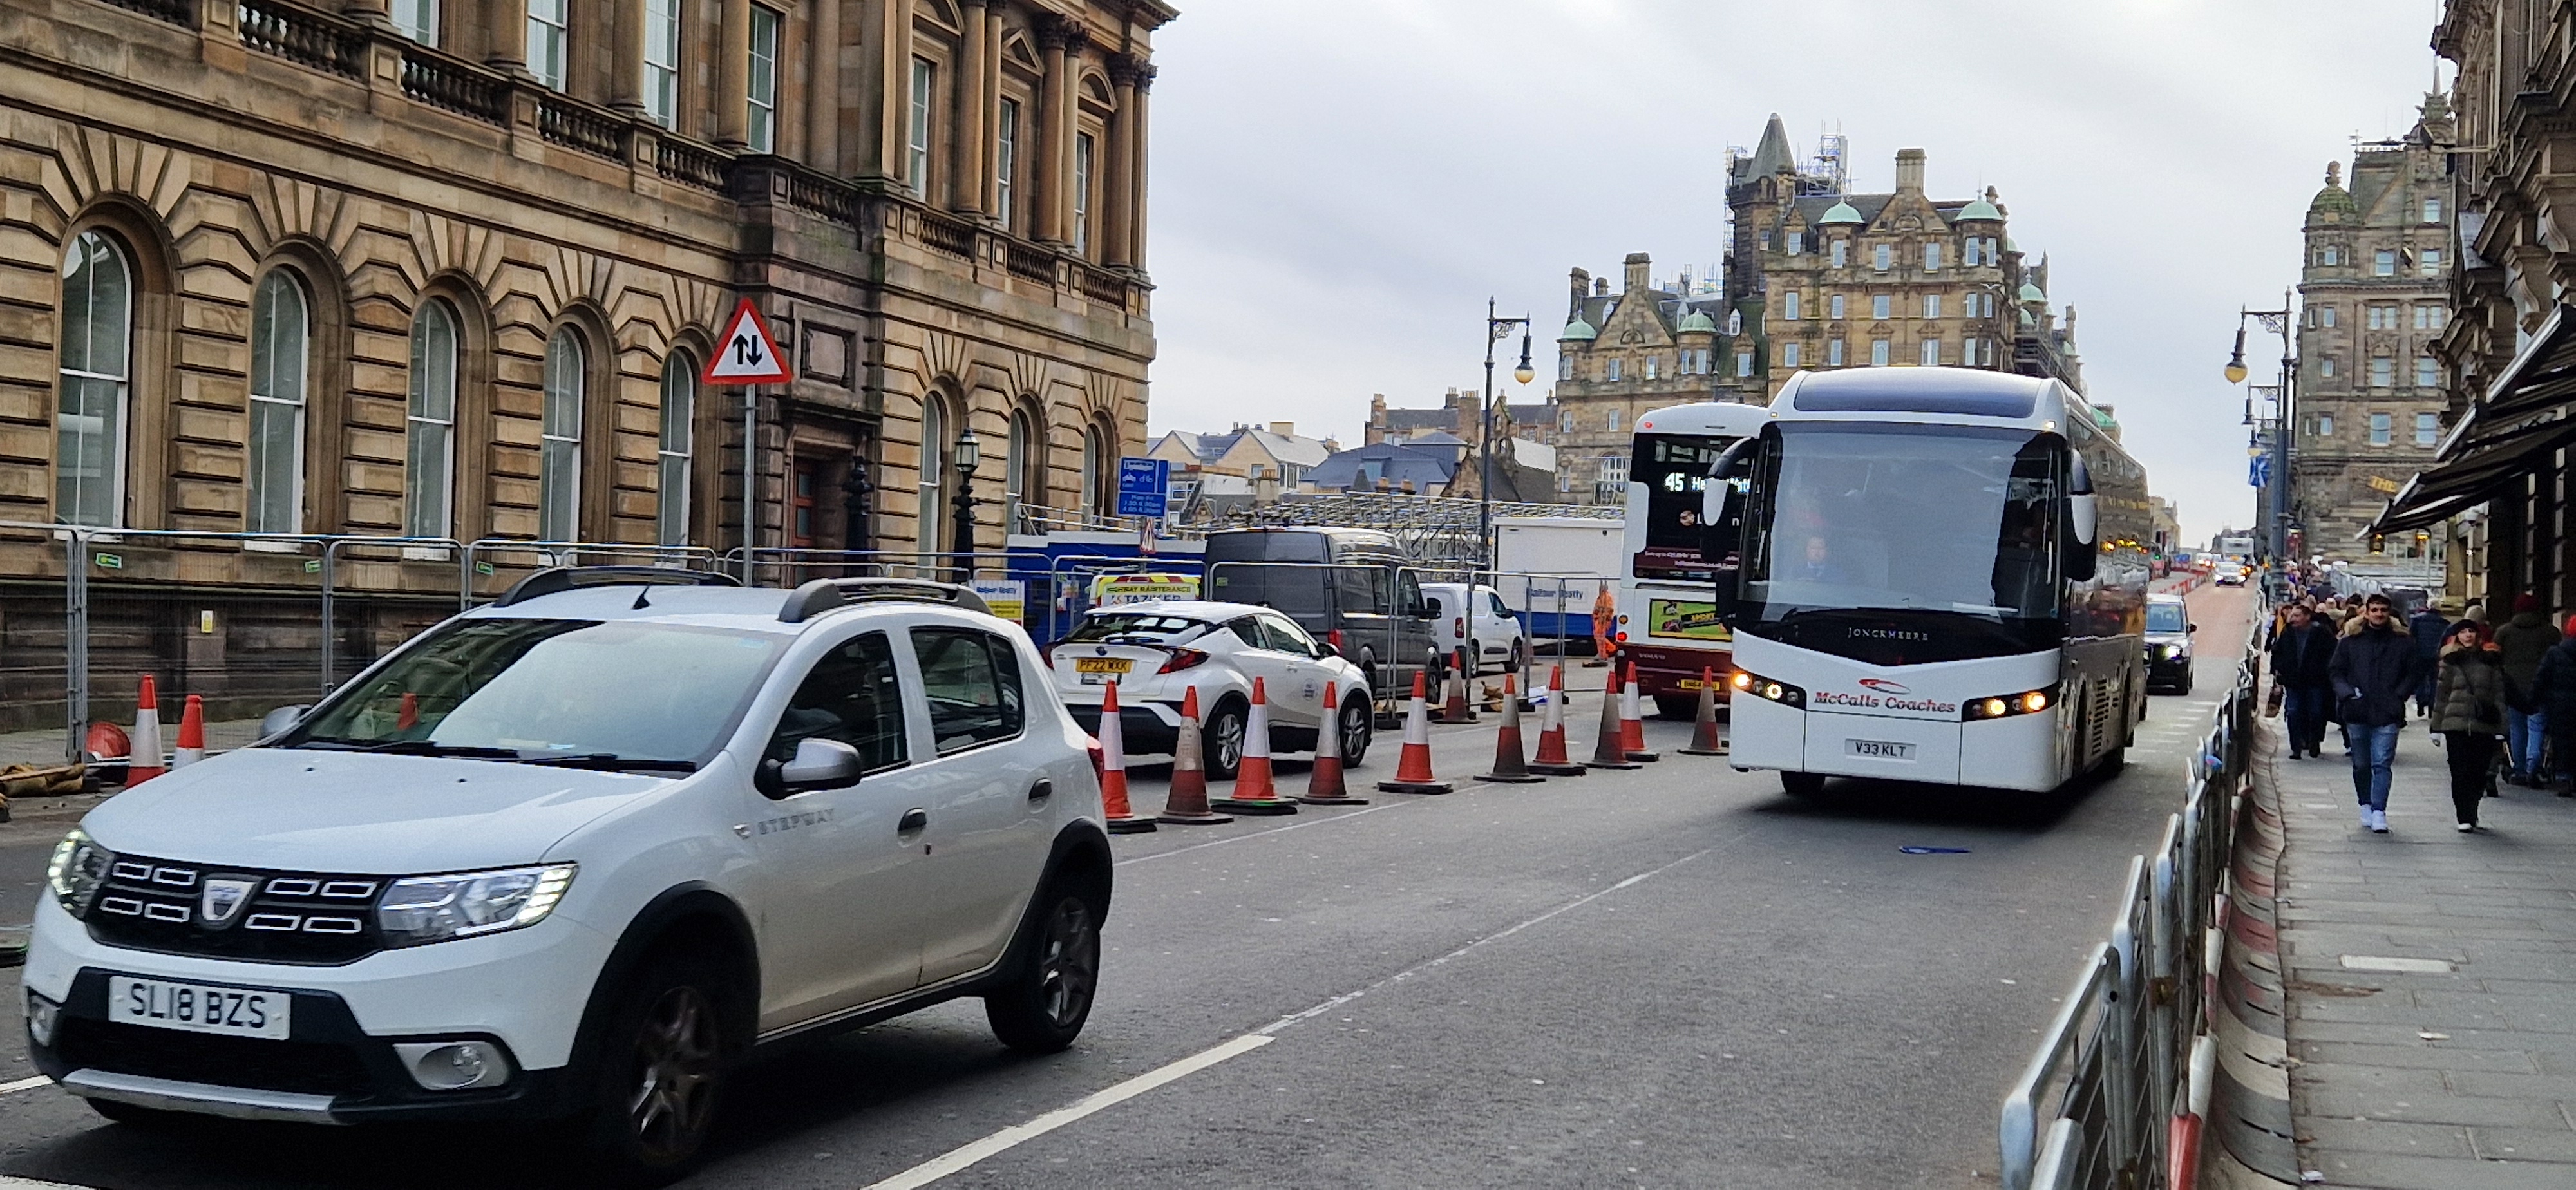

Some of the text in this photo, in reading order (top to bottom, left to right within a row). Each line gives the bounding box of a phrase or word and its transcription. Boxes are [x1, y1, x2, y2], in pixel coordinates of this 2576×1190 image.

[1665, 472, 1685, 491] 45
[1080, 659, 1105, 670] PF22
[1814, 692, 1956, 713] McCalls Coaches
[1855, 742, 1906, 757] V33 KLT
[758, 808, 835, 835] STEPWAY
[131, 983, 266, 1028] SL18 BZS
